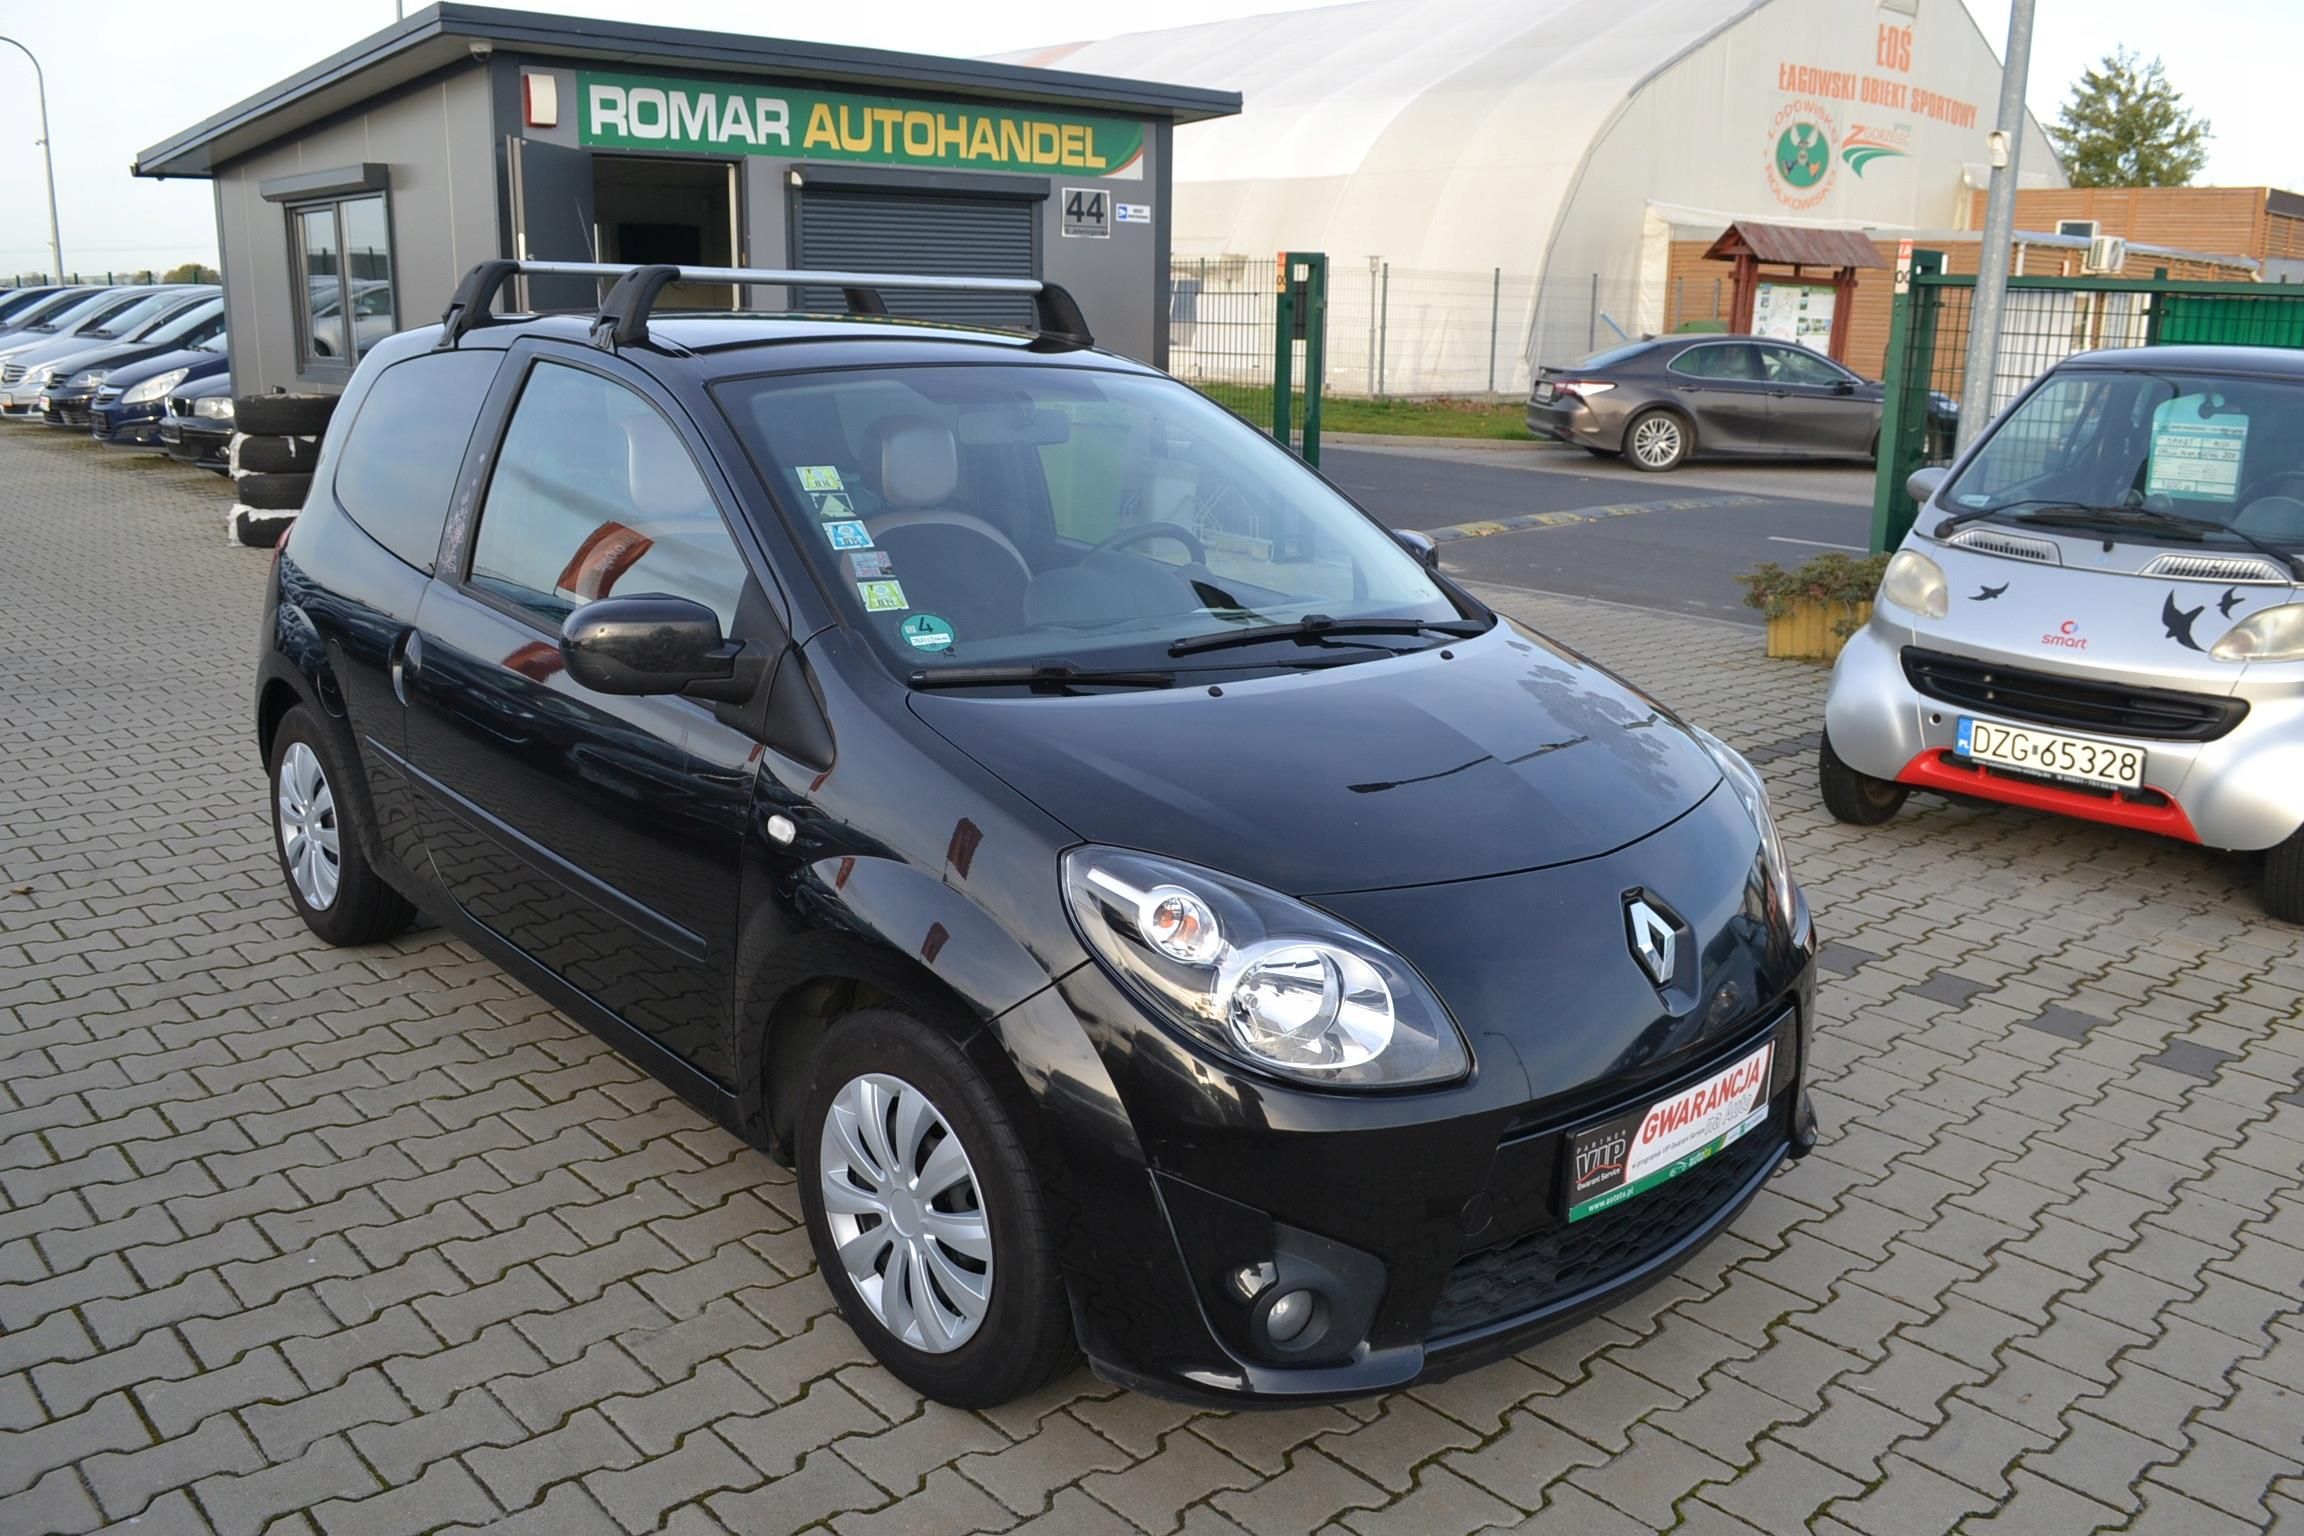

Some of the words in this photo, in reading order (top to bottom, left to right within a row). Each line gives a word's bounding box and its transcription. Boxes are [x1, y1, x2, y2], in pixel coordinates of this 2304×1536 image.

[1876, 23, 1913, 72] ŁOŚ
[1778, 62, 1856, 100] ŁAGOWSKI
[1861, 76, 1908, 111] OBIEKT
[1911, 87, 1979, 129] SPORTOWY
[589, 84, 790, 146] ROMAR
[803, 103, 1106, 168] AUTOHANDEL
[1066, 191, 1104, 224] 44
[919, 617, 933, 633] 4
[2041, 633, 2088, 650] smart
[1973, 725, 2029, 762] DZG
[2040, 740, 2137, 781] 65328
[1642, 1057, 1760, 1145] GWARANCJA
[1576, 1139, 1626, 1181] VIP
[1577, 1176, 1600, 1191] Gwarant
[1600, 1168, 1621, 1181] Service
